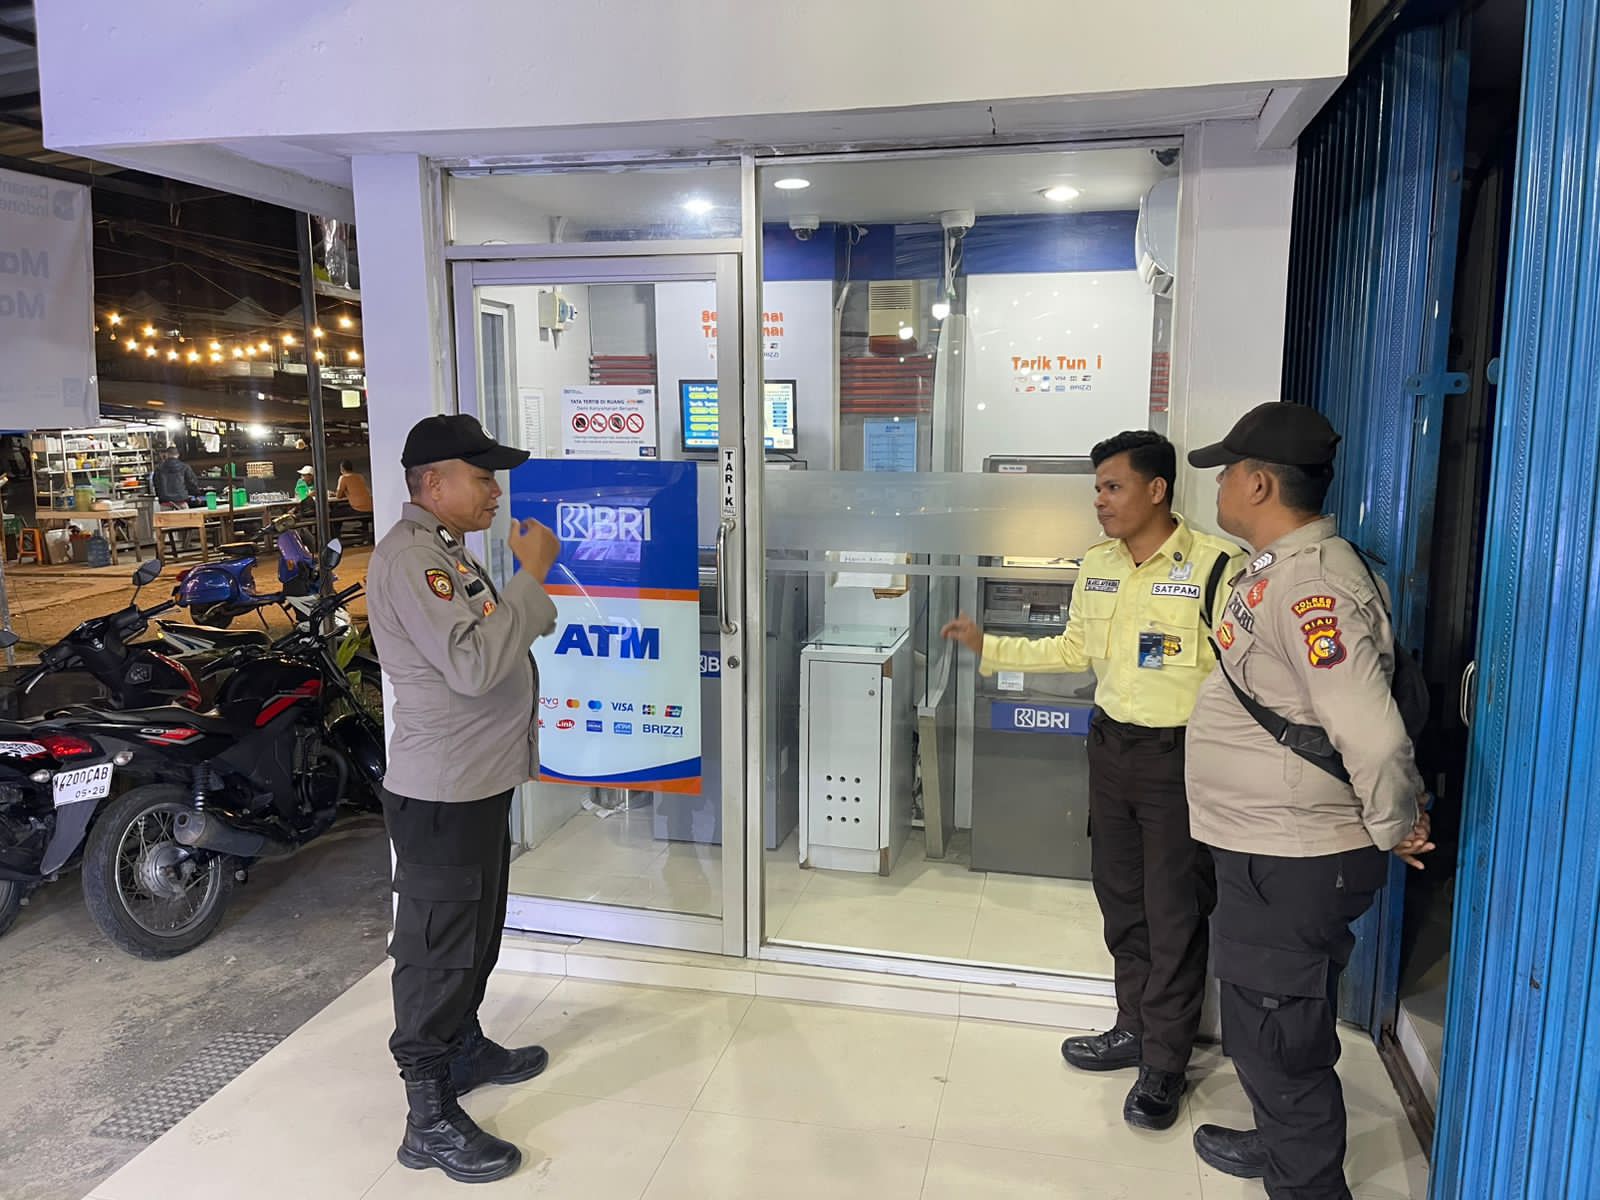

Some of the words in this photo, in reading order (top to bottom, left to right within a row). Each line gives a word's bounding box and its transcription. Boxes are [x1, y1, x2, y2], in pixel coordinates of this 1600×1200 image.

[1057, 354, 1102, 370] Tuni
[724, 451, 734, 507] TARIK
[594, 506, 651, 541] BRI
[1154, 585, 1198, 596] SATPAM
[1293, 597, 1332, 611] POLRES
[1304, 618, 1333, 631] RIAU
[554, 624, 660, 660] ATM
[611, 702, 634, 712] VISA
[1036, 710, 1070, 728] BRI
[642, 724, 684, 736] BRIZZI
